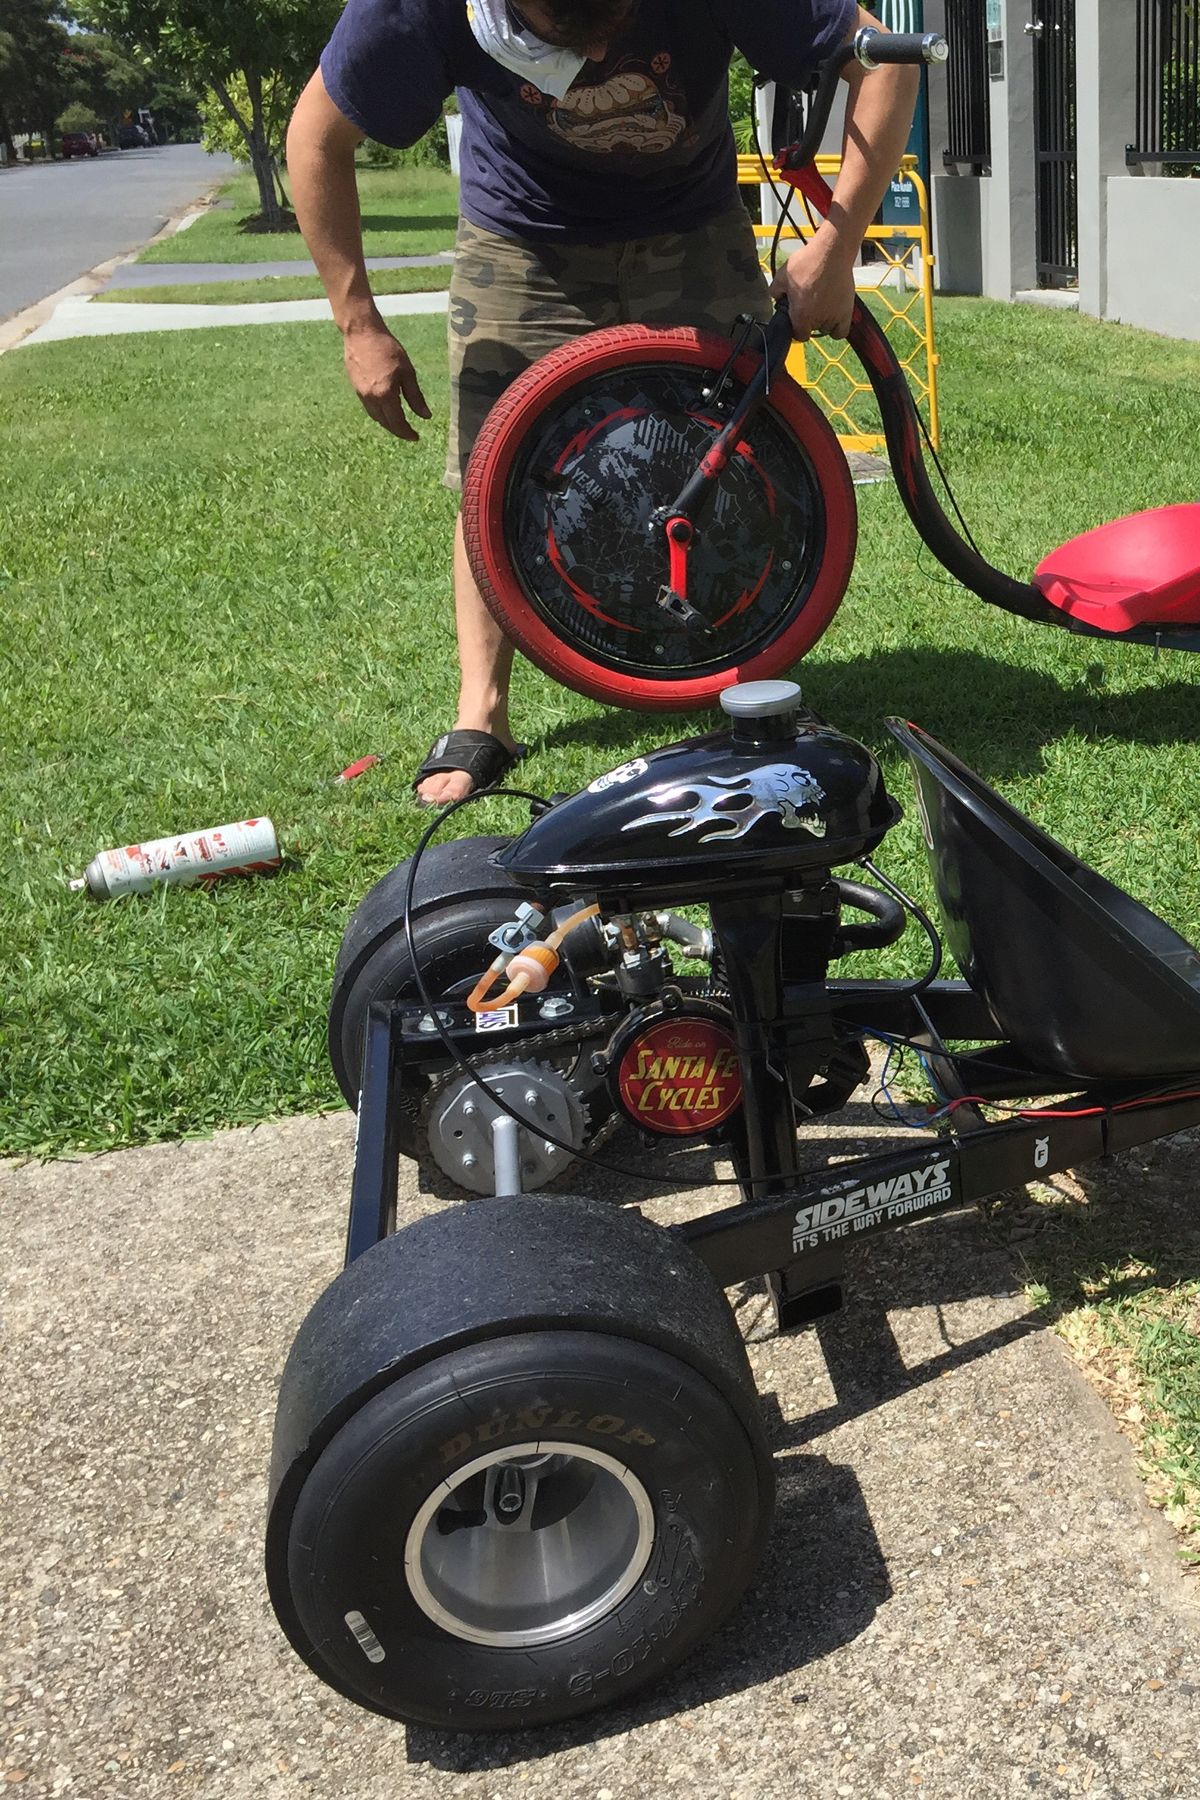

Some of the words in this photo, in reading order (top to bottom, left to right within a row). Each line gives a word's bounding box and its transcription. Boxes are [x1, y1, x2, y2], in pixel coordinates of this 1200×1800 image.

[629, 1049, 706, 1080] SANTA
[666, 1037, 692, 1049] Ride
[695, 1041, 707, 1049] on
[638, 1081, 725, 1111] CYCLES
[792, 1159, 951, 1236] SIDEWAYS
[792, 1233, 819, 1254] IT'S
[822, 1222, 850, 1243] THE
[853, 1209, 884, 1233] WAY
[887, 1187, 952, 1220] FORWARD
[438, 1406, 656, 1464] DUNLOP
